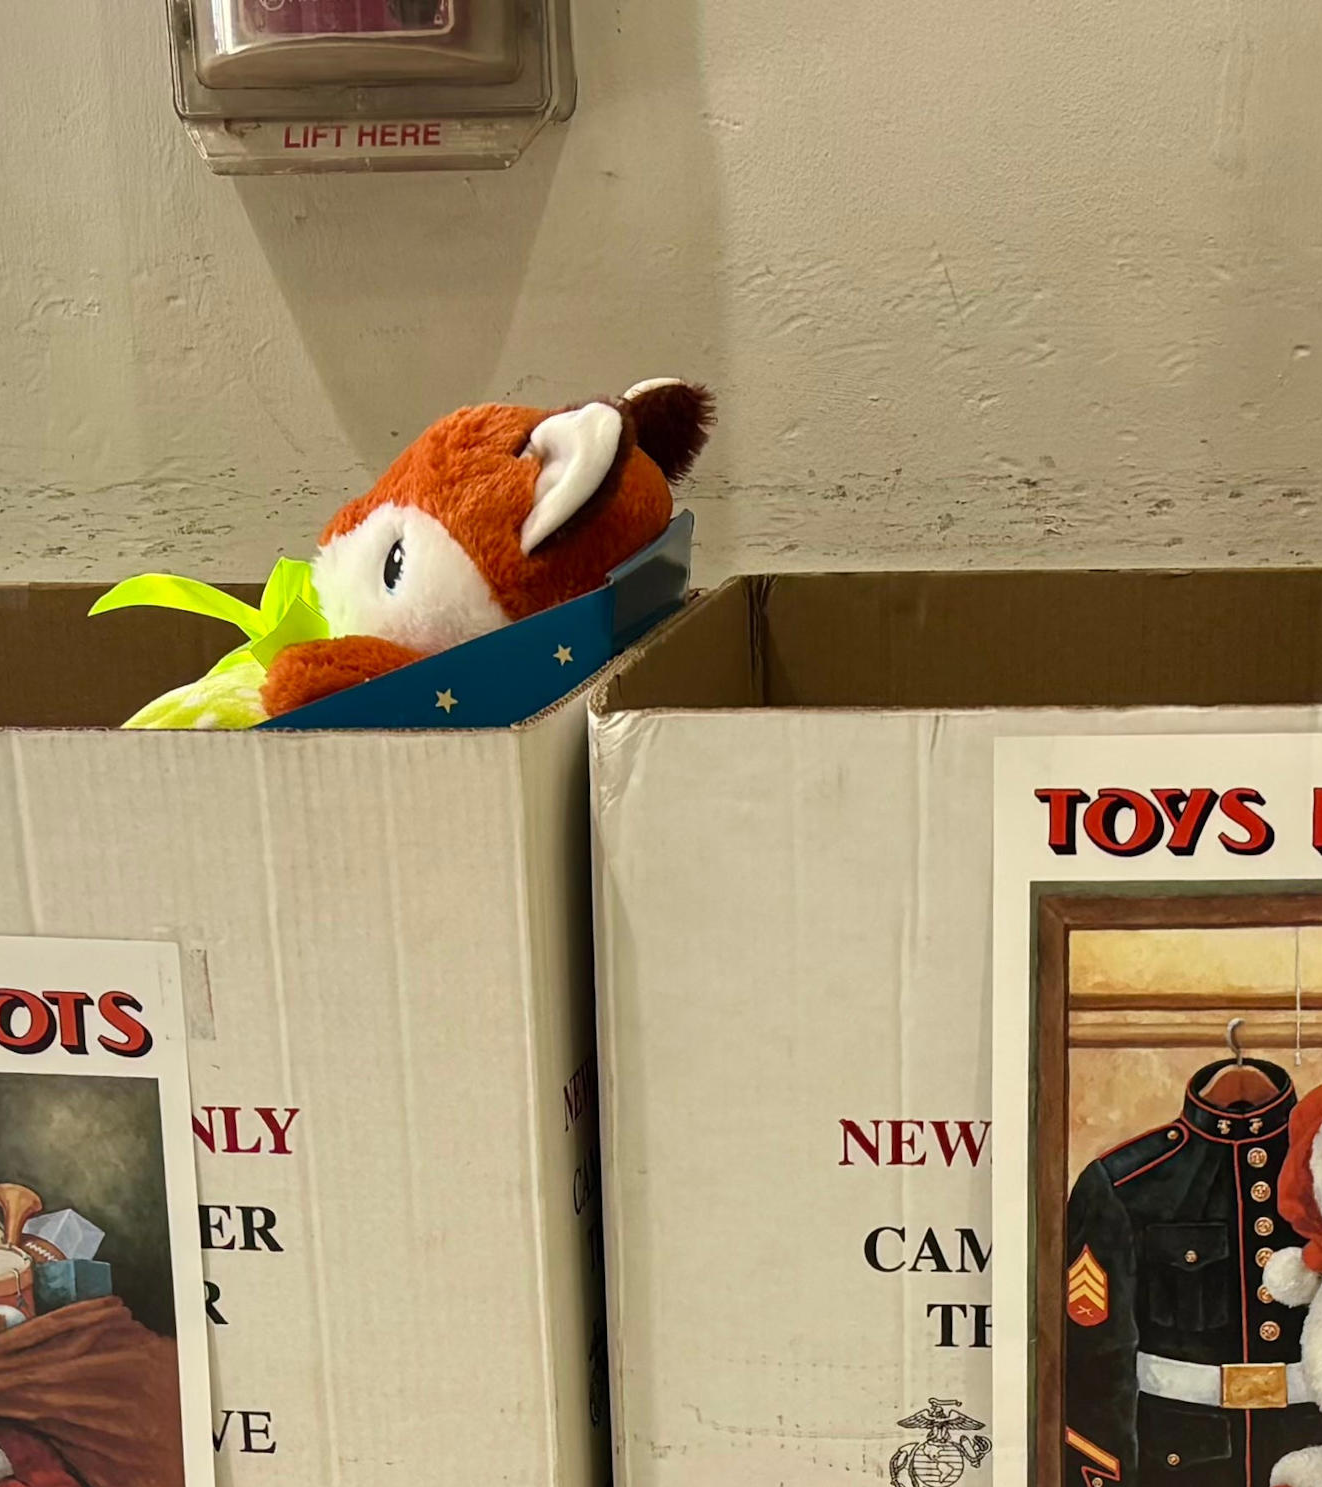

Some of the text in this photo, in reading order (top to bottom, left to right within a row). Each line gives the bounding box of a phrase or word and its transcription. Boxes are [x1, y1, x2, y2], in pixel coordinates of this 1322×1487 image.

[283, 123, 347, 150] LIFT
[356, 122, 443, 149] HERE
[1034, 788, 1275, 857] TOYS
